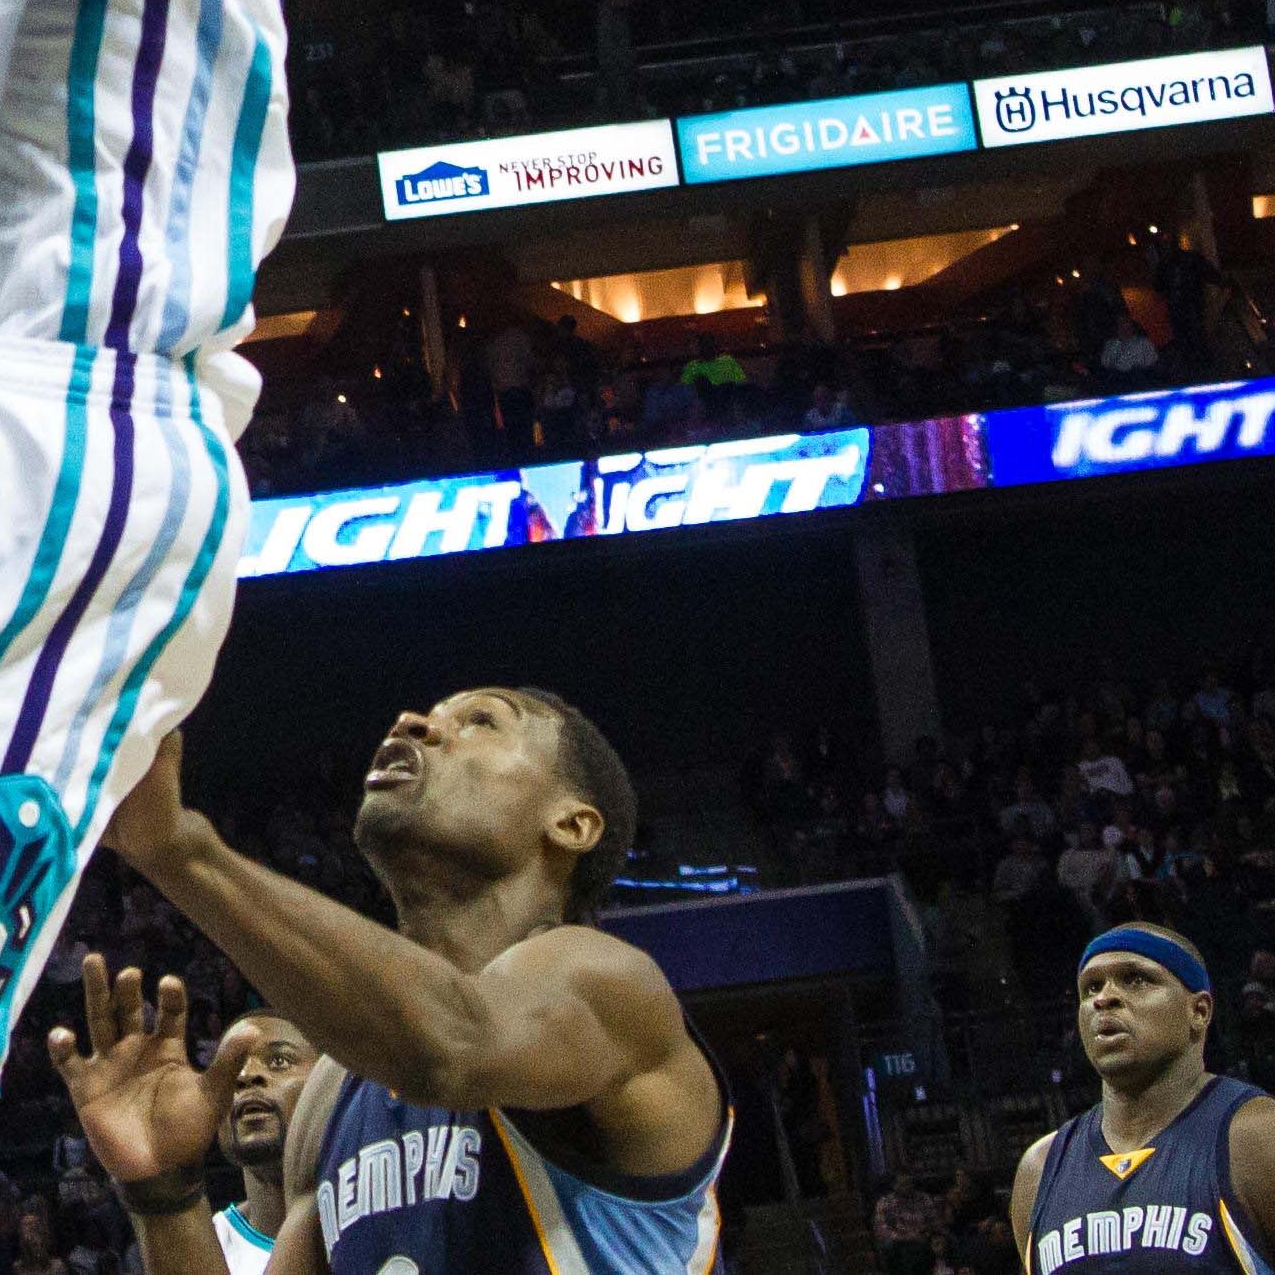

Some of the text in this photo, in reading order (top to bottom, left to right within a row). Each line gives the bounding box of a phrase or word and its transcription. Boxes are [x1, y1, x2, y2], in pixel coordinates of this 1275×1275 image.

[1041, 70, 1255, 122] Husqvarna
[697, 104, 957, 166] FRIGIDAIRE
[499, 151, 598, 174] NEVER STOP
[513, 156, 664, 192] IMPROVING
[404, 172, 483, 203] LOWE'S
[1038, 1205, 1212, 1275] MEMPHIS
